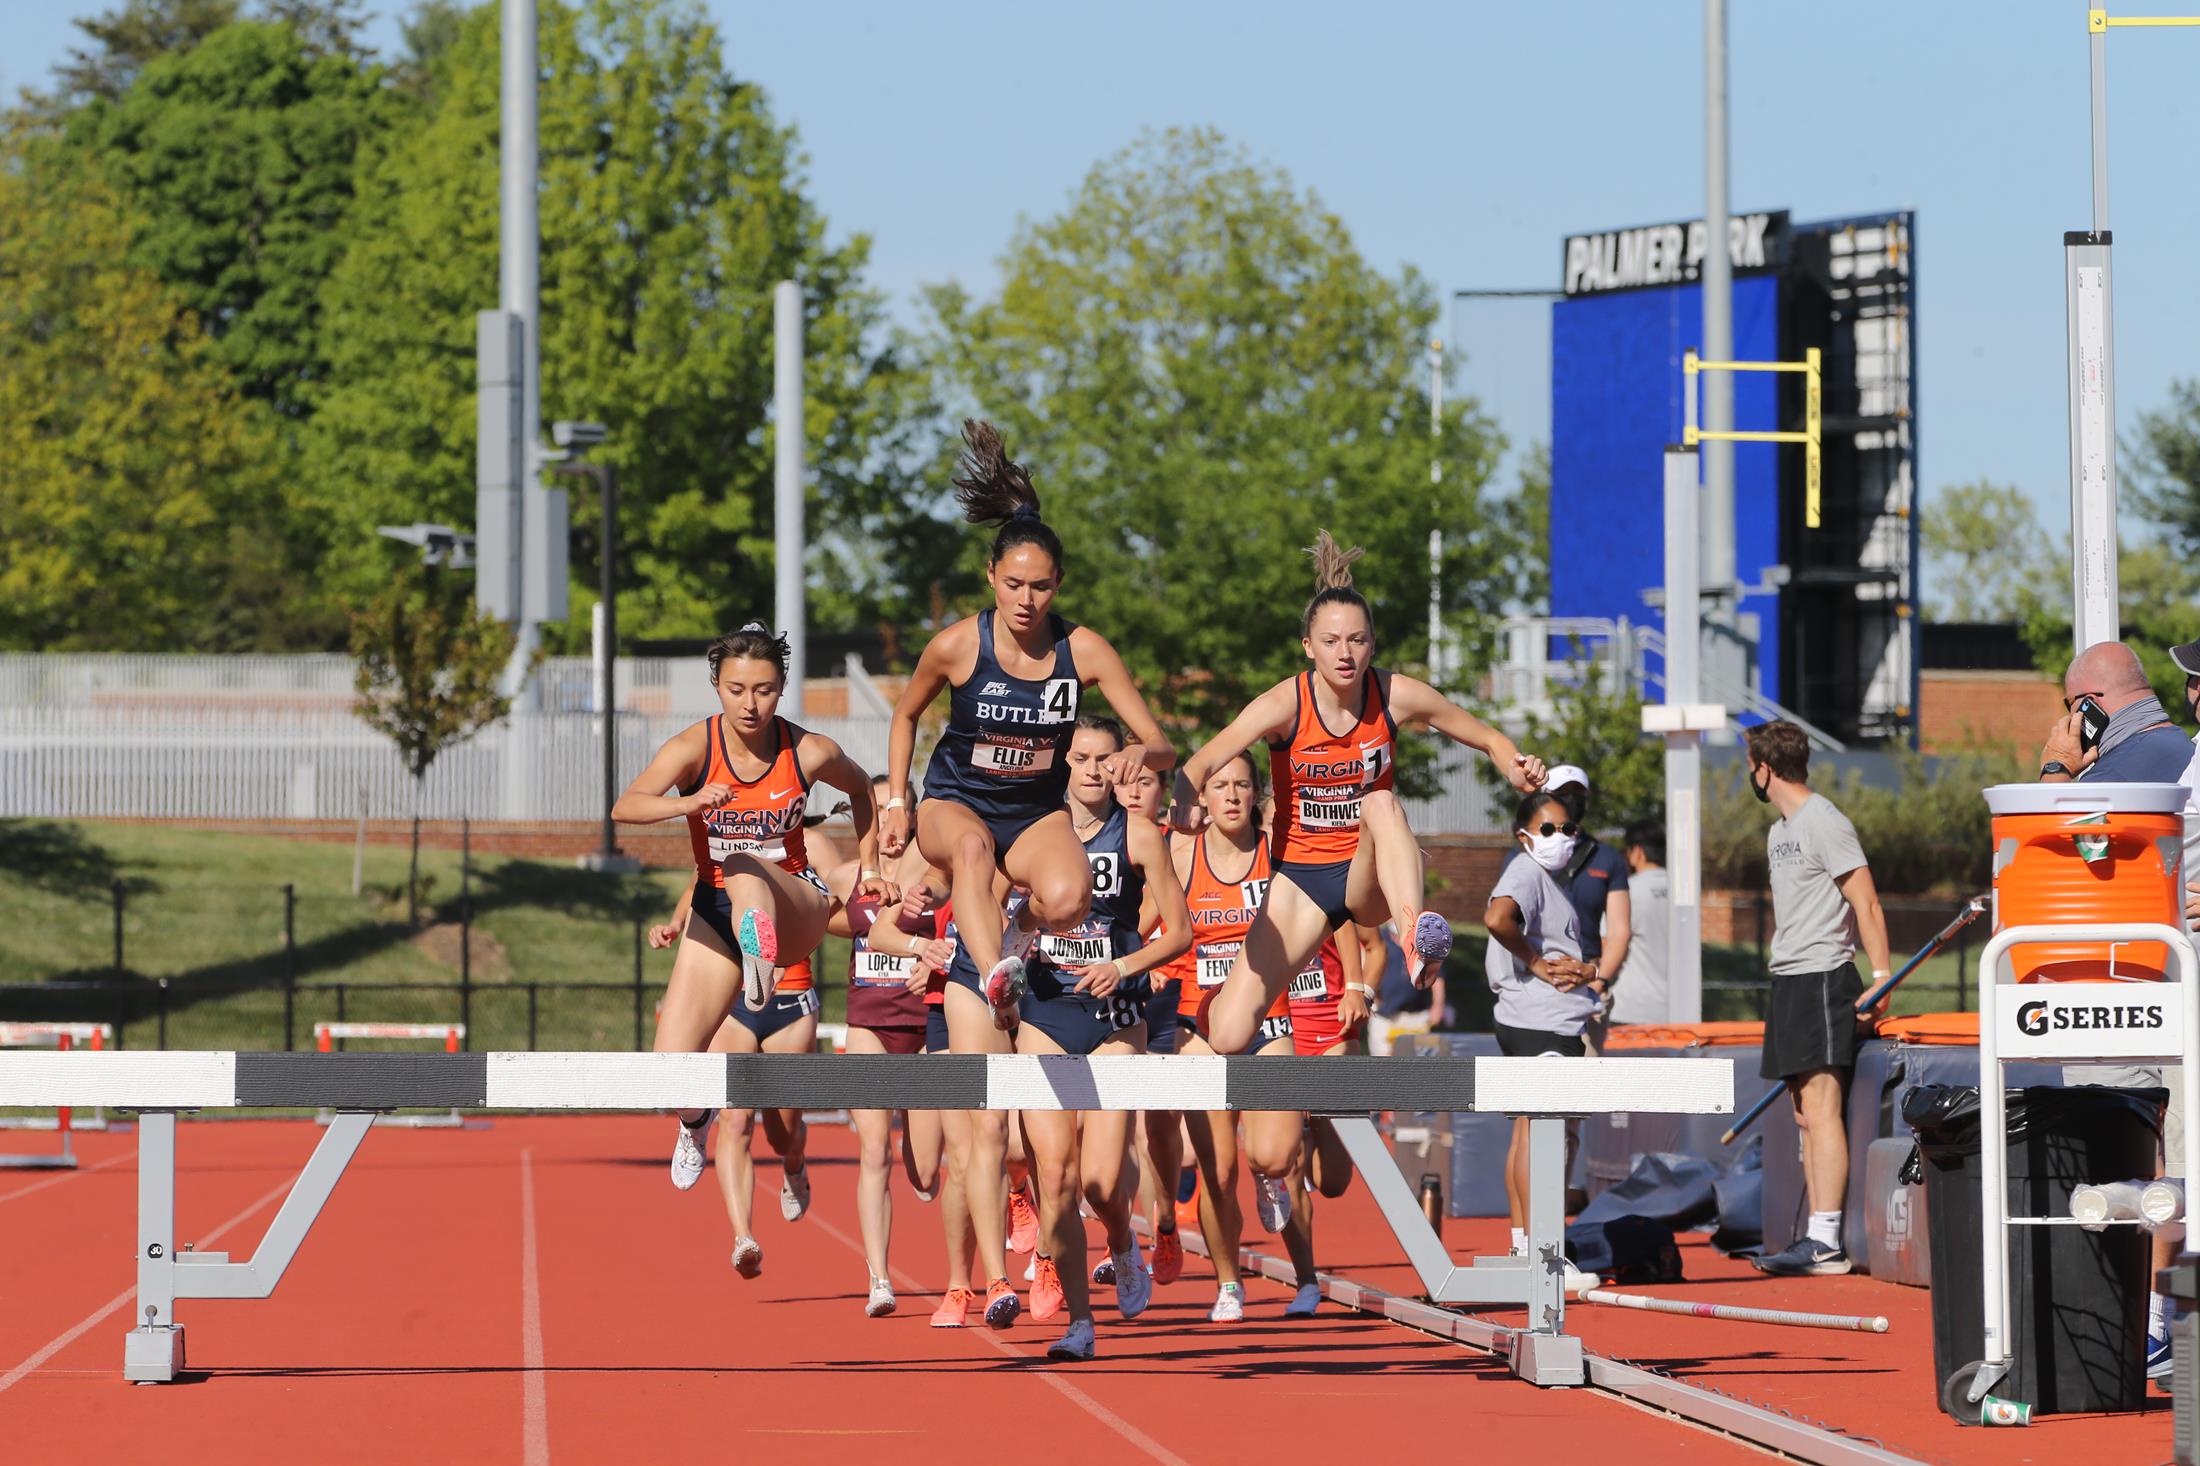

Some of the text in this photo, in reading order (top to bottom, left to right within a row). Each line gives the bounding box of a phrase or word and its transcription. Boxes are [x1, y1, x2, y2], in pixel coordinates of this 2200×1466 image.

[1566, 214, 1768, 294] PALMER PRK
[987, 681, 1008, 689] BIG
[1049, 682, 1072, 719] 4
[976, 702, 1063, 725] BUTLE
[984, 734, 1034, 747] VIRGINIA
[992, 746, 1035, 767] ELLIS
[1368, 749, 1382, 780] 1
[1290, 757, 1364, 779] VIRGIN
[1306, 784, 1354, 797] VIRGINIA
[784, 797, 804, 830] 6
[1303, 801, 1361, 820] BOTHWE
[715, 824, 763, 835] VIRGINIA
[721, 841, 764, 852] LINDSAY
[1092, 855, 1113, 892] 8
[1190, 908, 1259, 925] VIRGIN
[1048, 938, 1104, 960] JORDAN
[1200, 942, 1241, 954] VIRGINIA
[868, 954, 902, 971] LOPEZ
[1289, 972, 1322, 993] KING
[1112, 997, 1136, 1028] 8
[2017, 1000, 2163, 1036] G SERIES
[1266, 1017, 1290, 1037] 15
